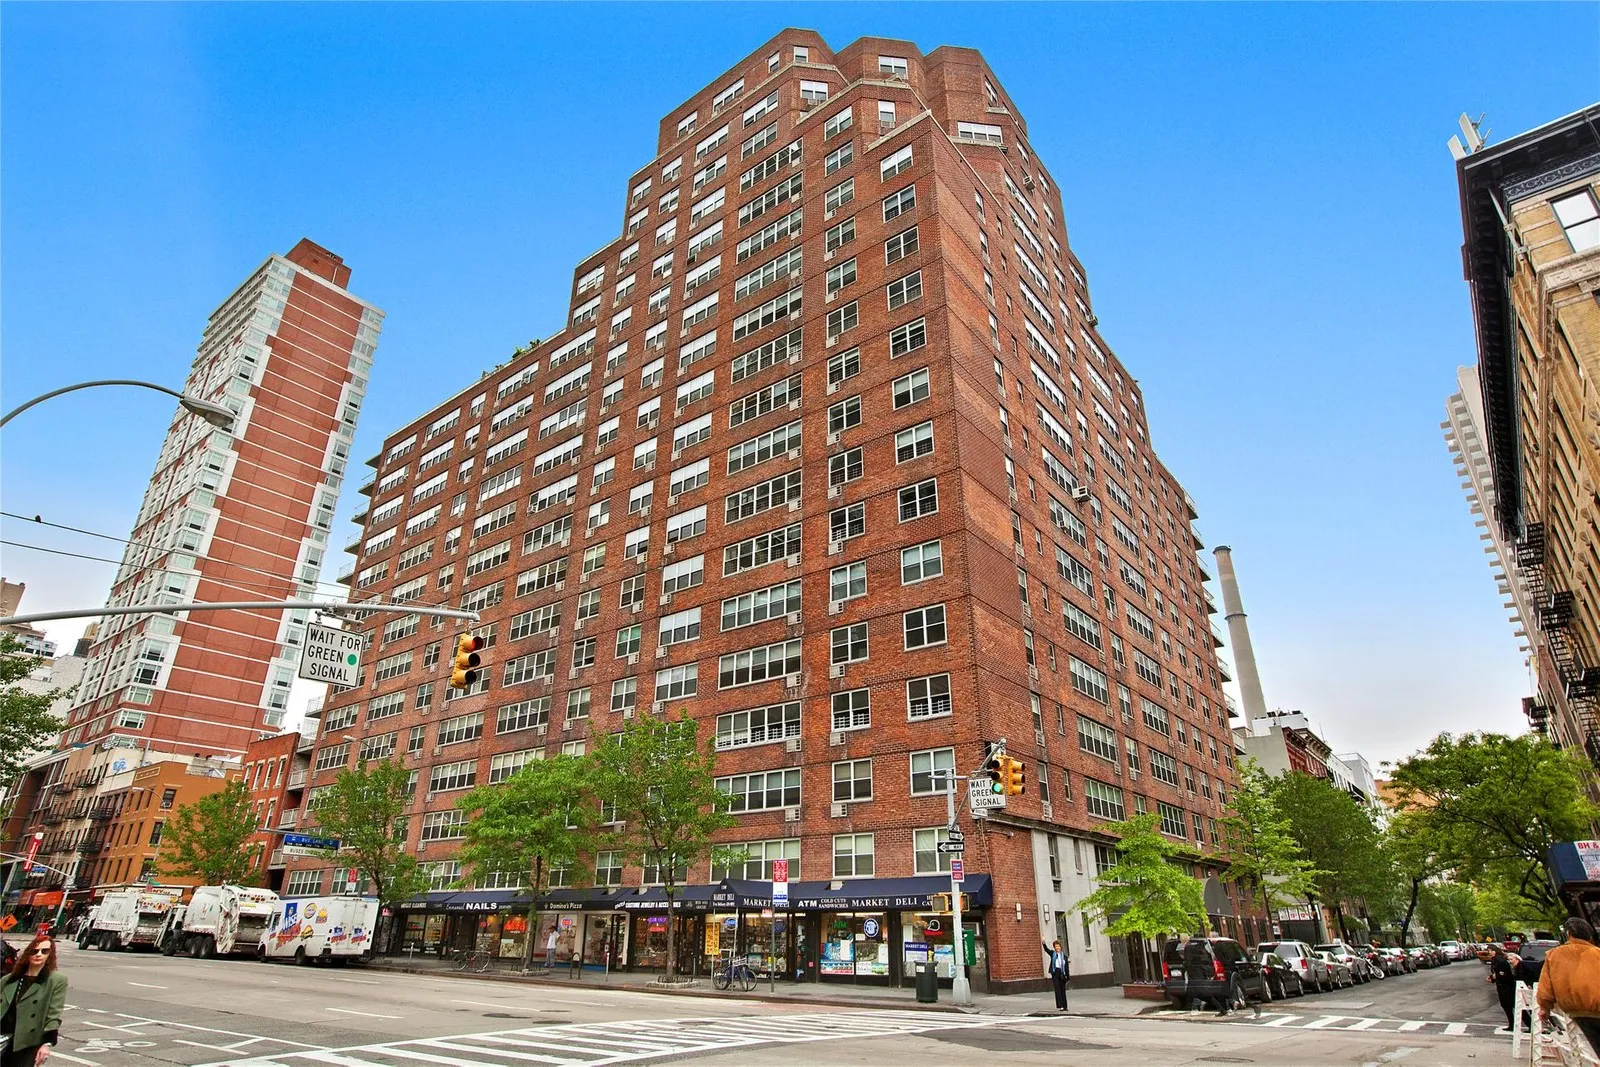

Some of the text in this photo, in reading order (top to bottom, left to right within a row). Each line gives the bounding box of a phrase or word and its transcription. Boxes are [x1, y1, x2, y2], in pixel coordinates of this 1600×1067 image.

[310, 628, 361, 651] WAIT FOR
[308, 645, 344, 663] GREEN
[310, 663, 349, 682] SIGNAL
[971, 780, 986, 789] WAIT
[976, 798, 1001, 806] SIGNAL
[465, 902, 498, 910] NAILS
[743, 898, 772, 907] MARKET
[798, 900, 818, 908] ATM
[852, 898, 890, 907] MARKET
[895, 897, 918, 906] DELI
